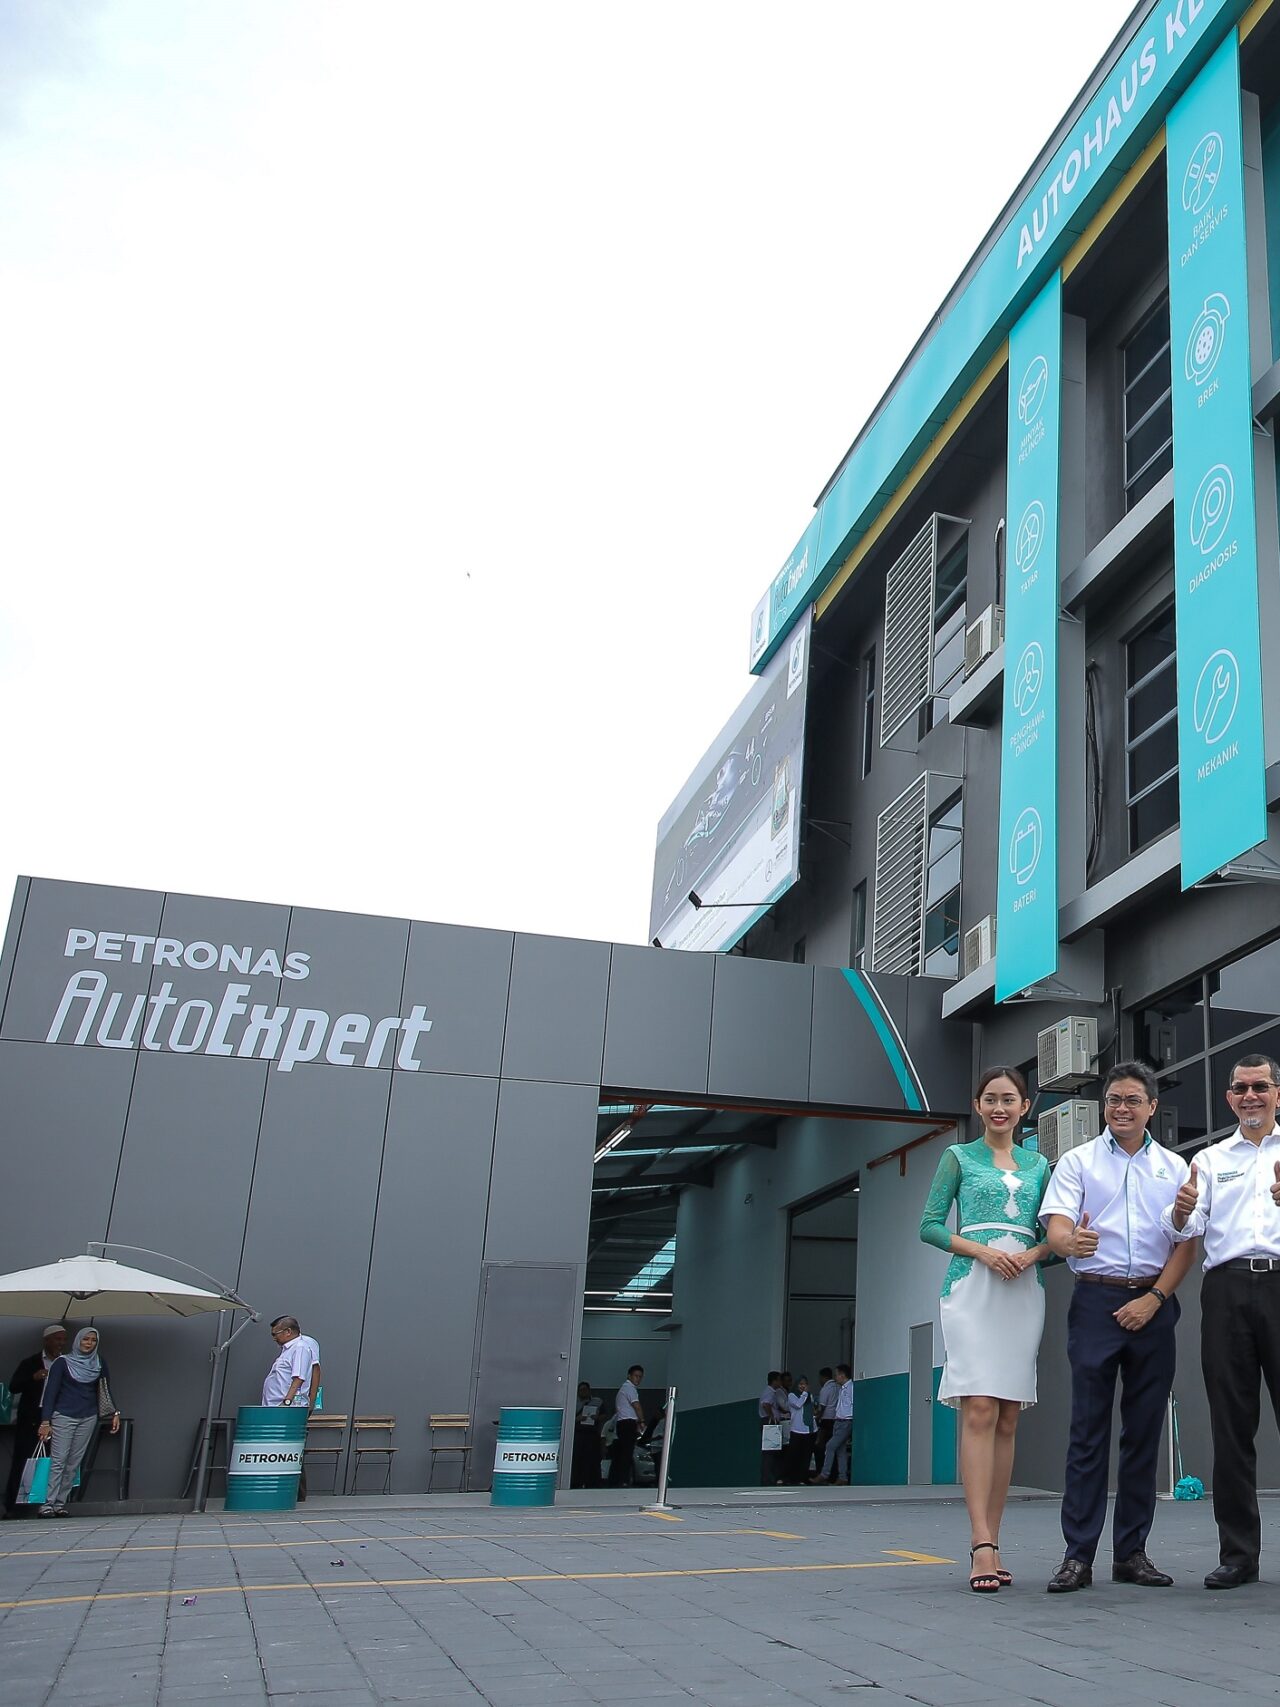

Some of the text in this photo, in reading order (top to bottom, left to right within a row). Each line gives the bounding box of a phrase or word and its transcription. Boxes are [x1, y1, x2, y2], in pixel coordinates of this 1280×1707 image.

[1016, 37, 1157, 270] AUTOHAUS
[1181, 203, 1228, 268] DAN SERVIS
[1193, 205, 1214, 238] BAIKI
[1197, 381, 1220, 409] BREK
[1020, 570, 1039, 596] TAYAR
[1189, 540, 1239, 593] DIAGNOSIS
[1010, 709, 1045, 748] PENGHAWA
[1015, 731, 1039, 758] DINGIN
[1196, 741, 1239, 783] MEKANIK
[1013, 888, 1037, 912] BATERI
[63, 928, 311, 980] PETRONAS
[45, 970, 433, 1072] AutoExpert
[238, 1452, 299, 1463] PETRONAS
[502, 1452, 556, 1463] PETRONAS
